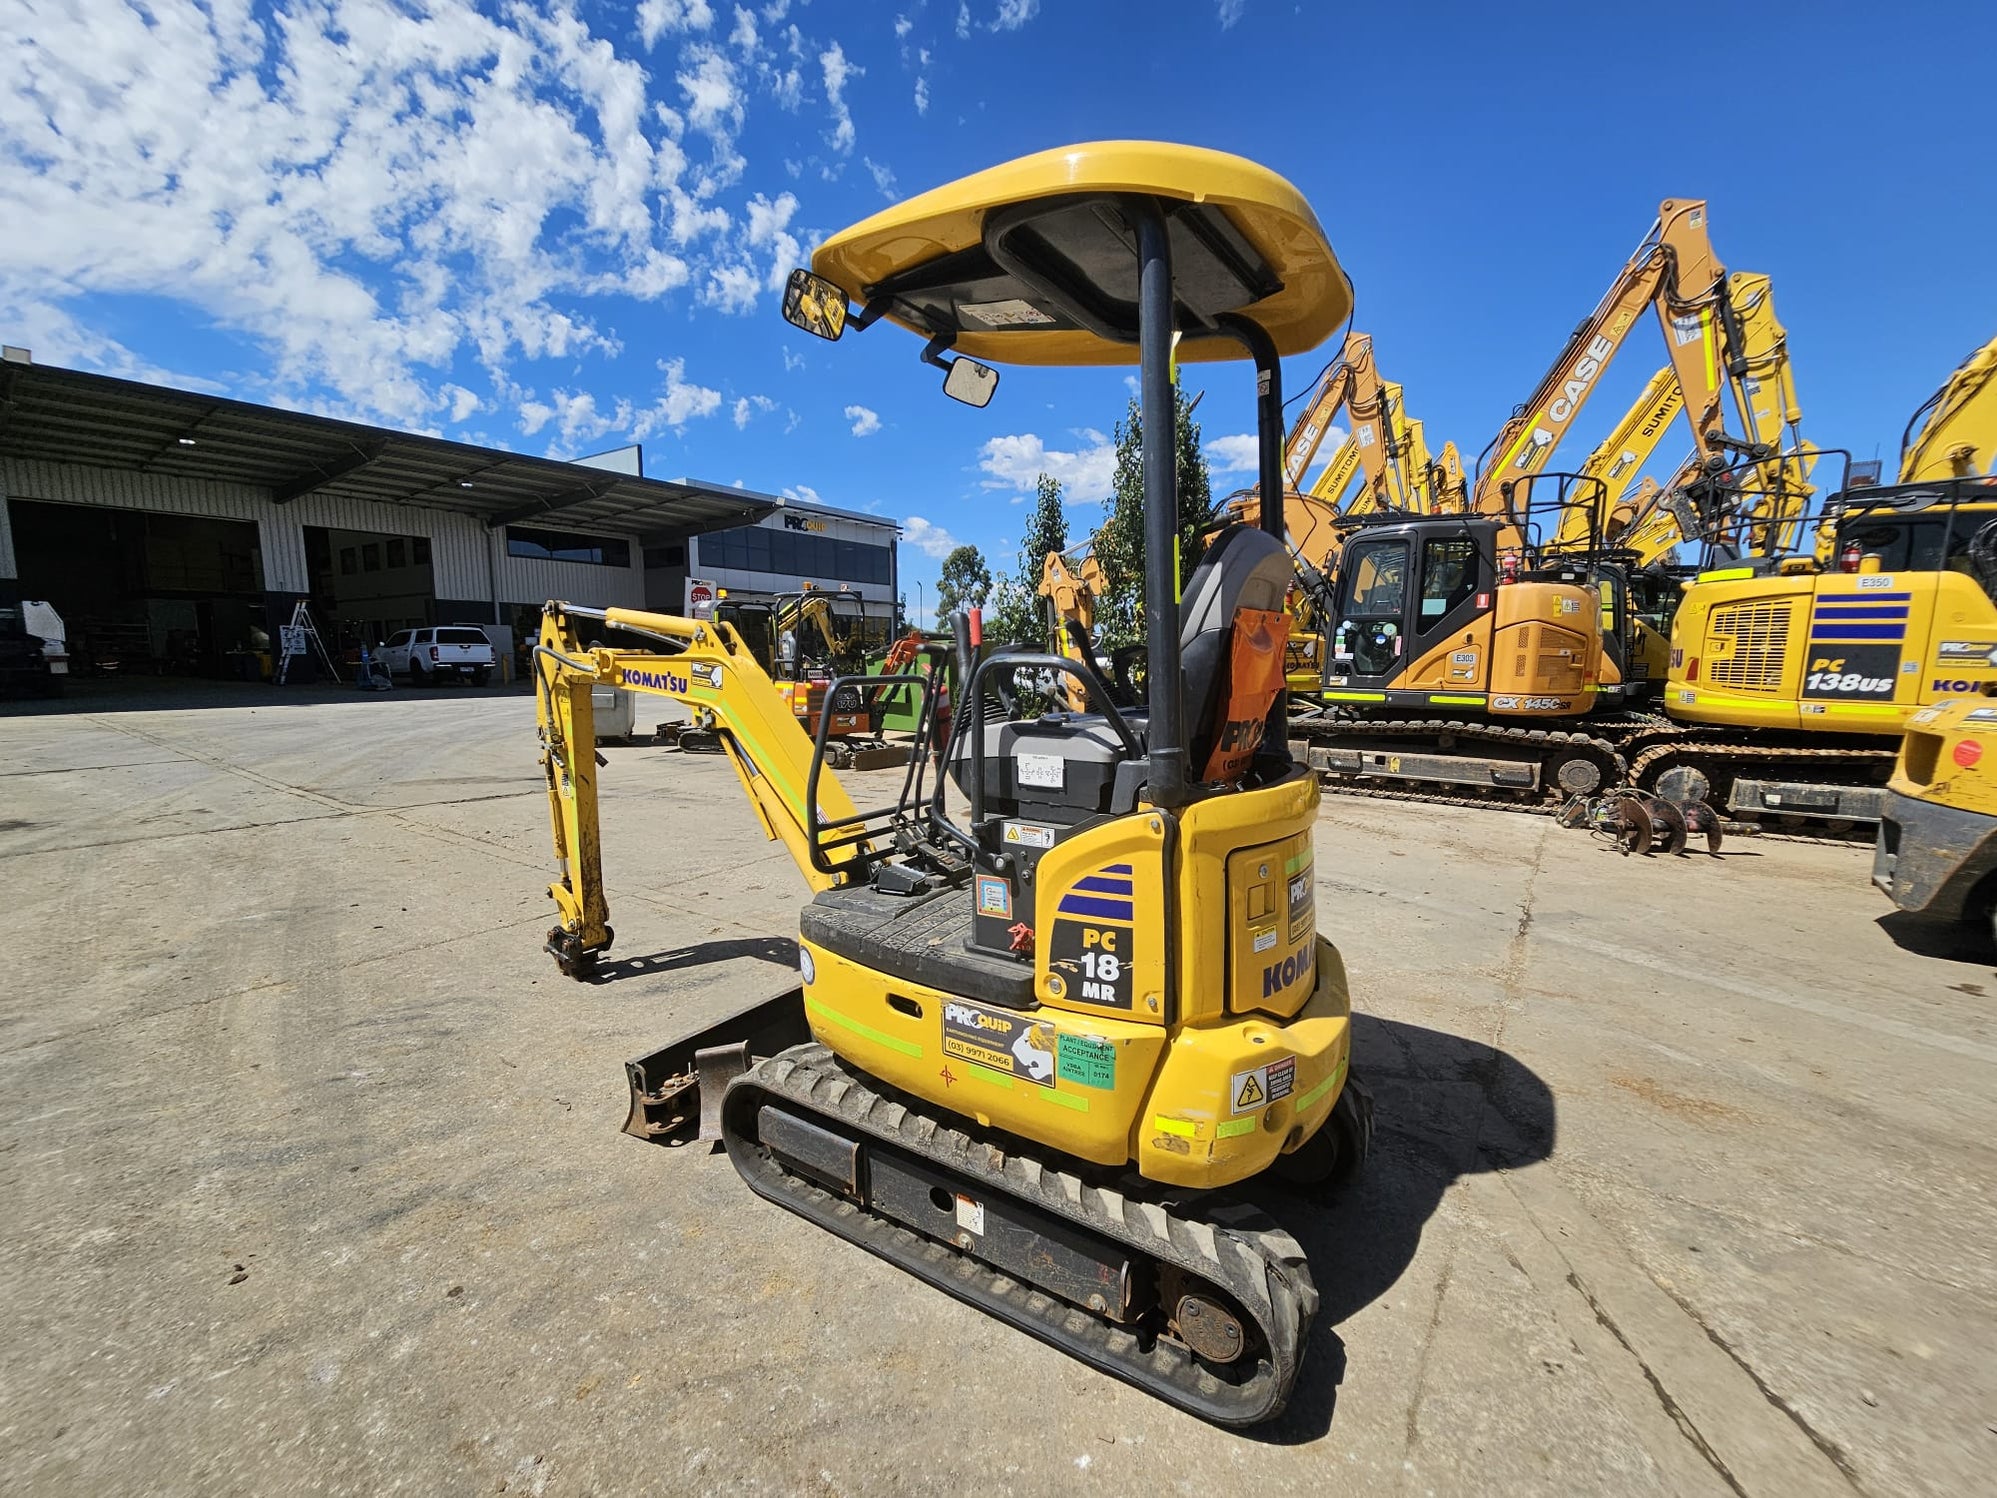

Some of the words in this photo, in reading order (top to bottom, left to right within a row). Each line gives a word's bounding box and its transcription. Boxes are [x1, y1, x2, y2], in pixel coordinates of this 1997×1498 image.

[1549, 334, 1614, 423] CASE
[1861, 577, 1890, 588] E350
[692, 593, 710, 602] STOP
[1456, 654, 1474, 663] E303
[1811, 659, 1846, 672] PC
[622, 668, 688, 694] KOMATSU
[1493, 696, 1522, 710] CX
[1082, 928, 1116, 952] PC
[1081, 951, 1120, 982] 18
[1081, 981, 1116, 1002] MR
[948, 1040, 964, 1053] (03)
[965, 1046, 986, 1058] 9971
[987, 1053, 1010, 1067] 2066
[1062, 1045, 1110, 1062] ACCEPTANCE
